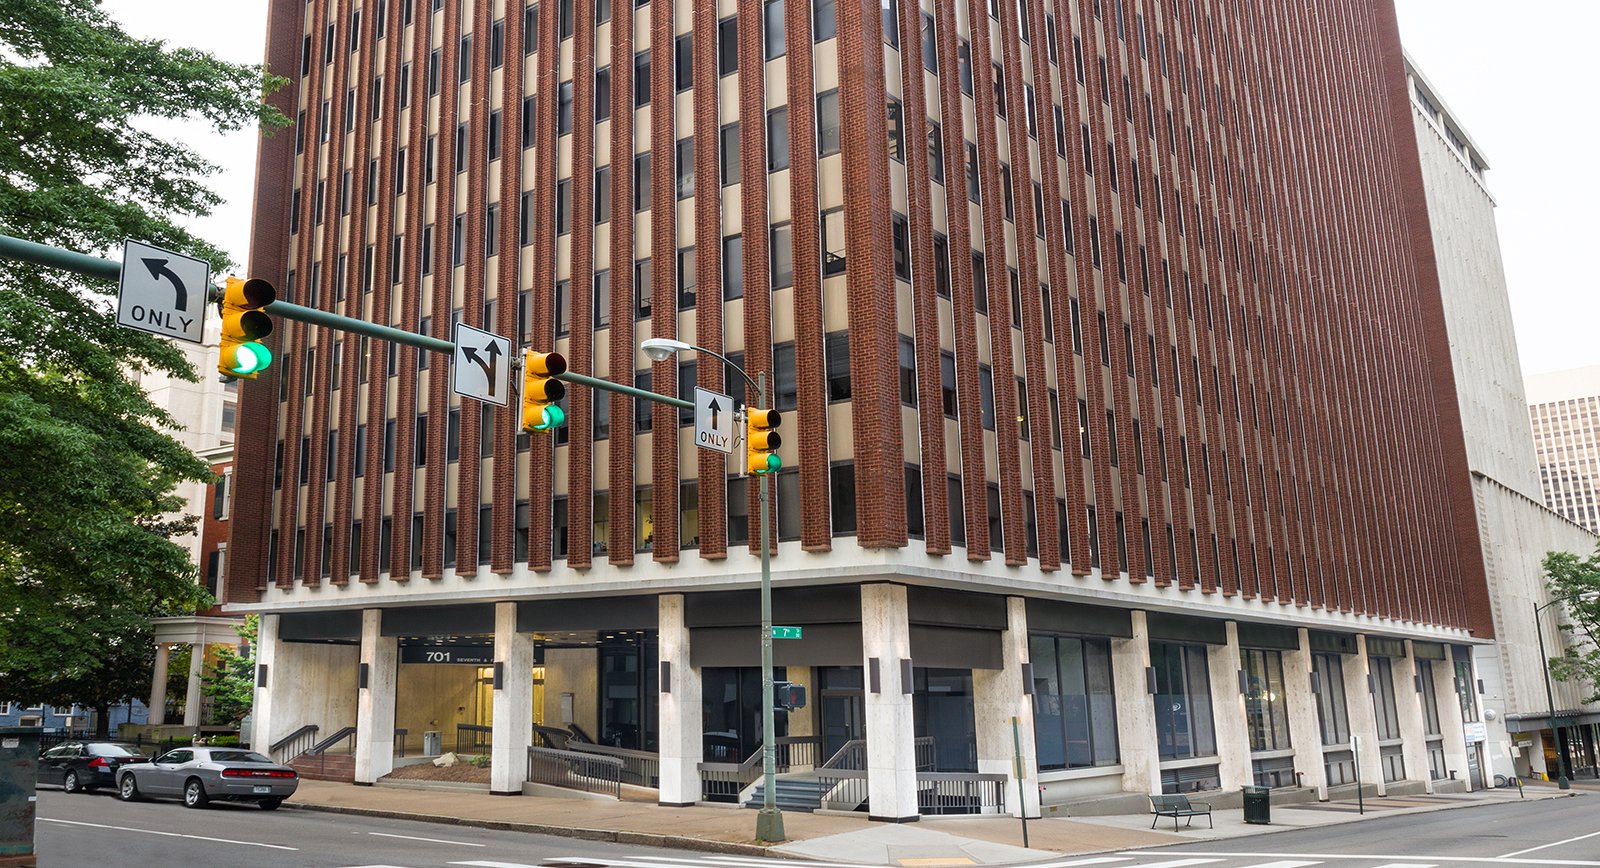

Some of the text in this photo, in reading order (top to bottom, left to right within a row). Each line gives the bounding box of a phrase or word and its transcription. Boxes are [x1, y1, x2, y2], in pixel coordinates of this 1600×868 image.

[131, 304, 194, 333] ONLY
[701, 431, 728, 447] ONLY
[426, 651, 450, 662] 701
